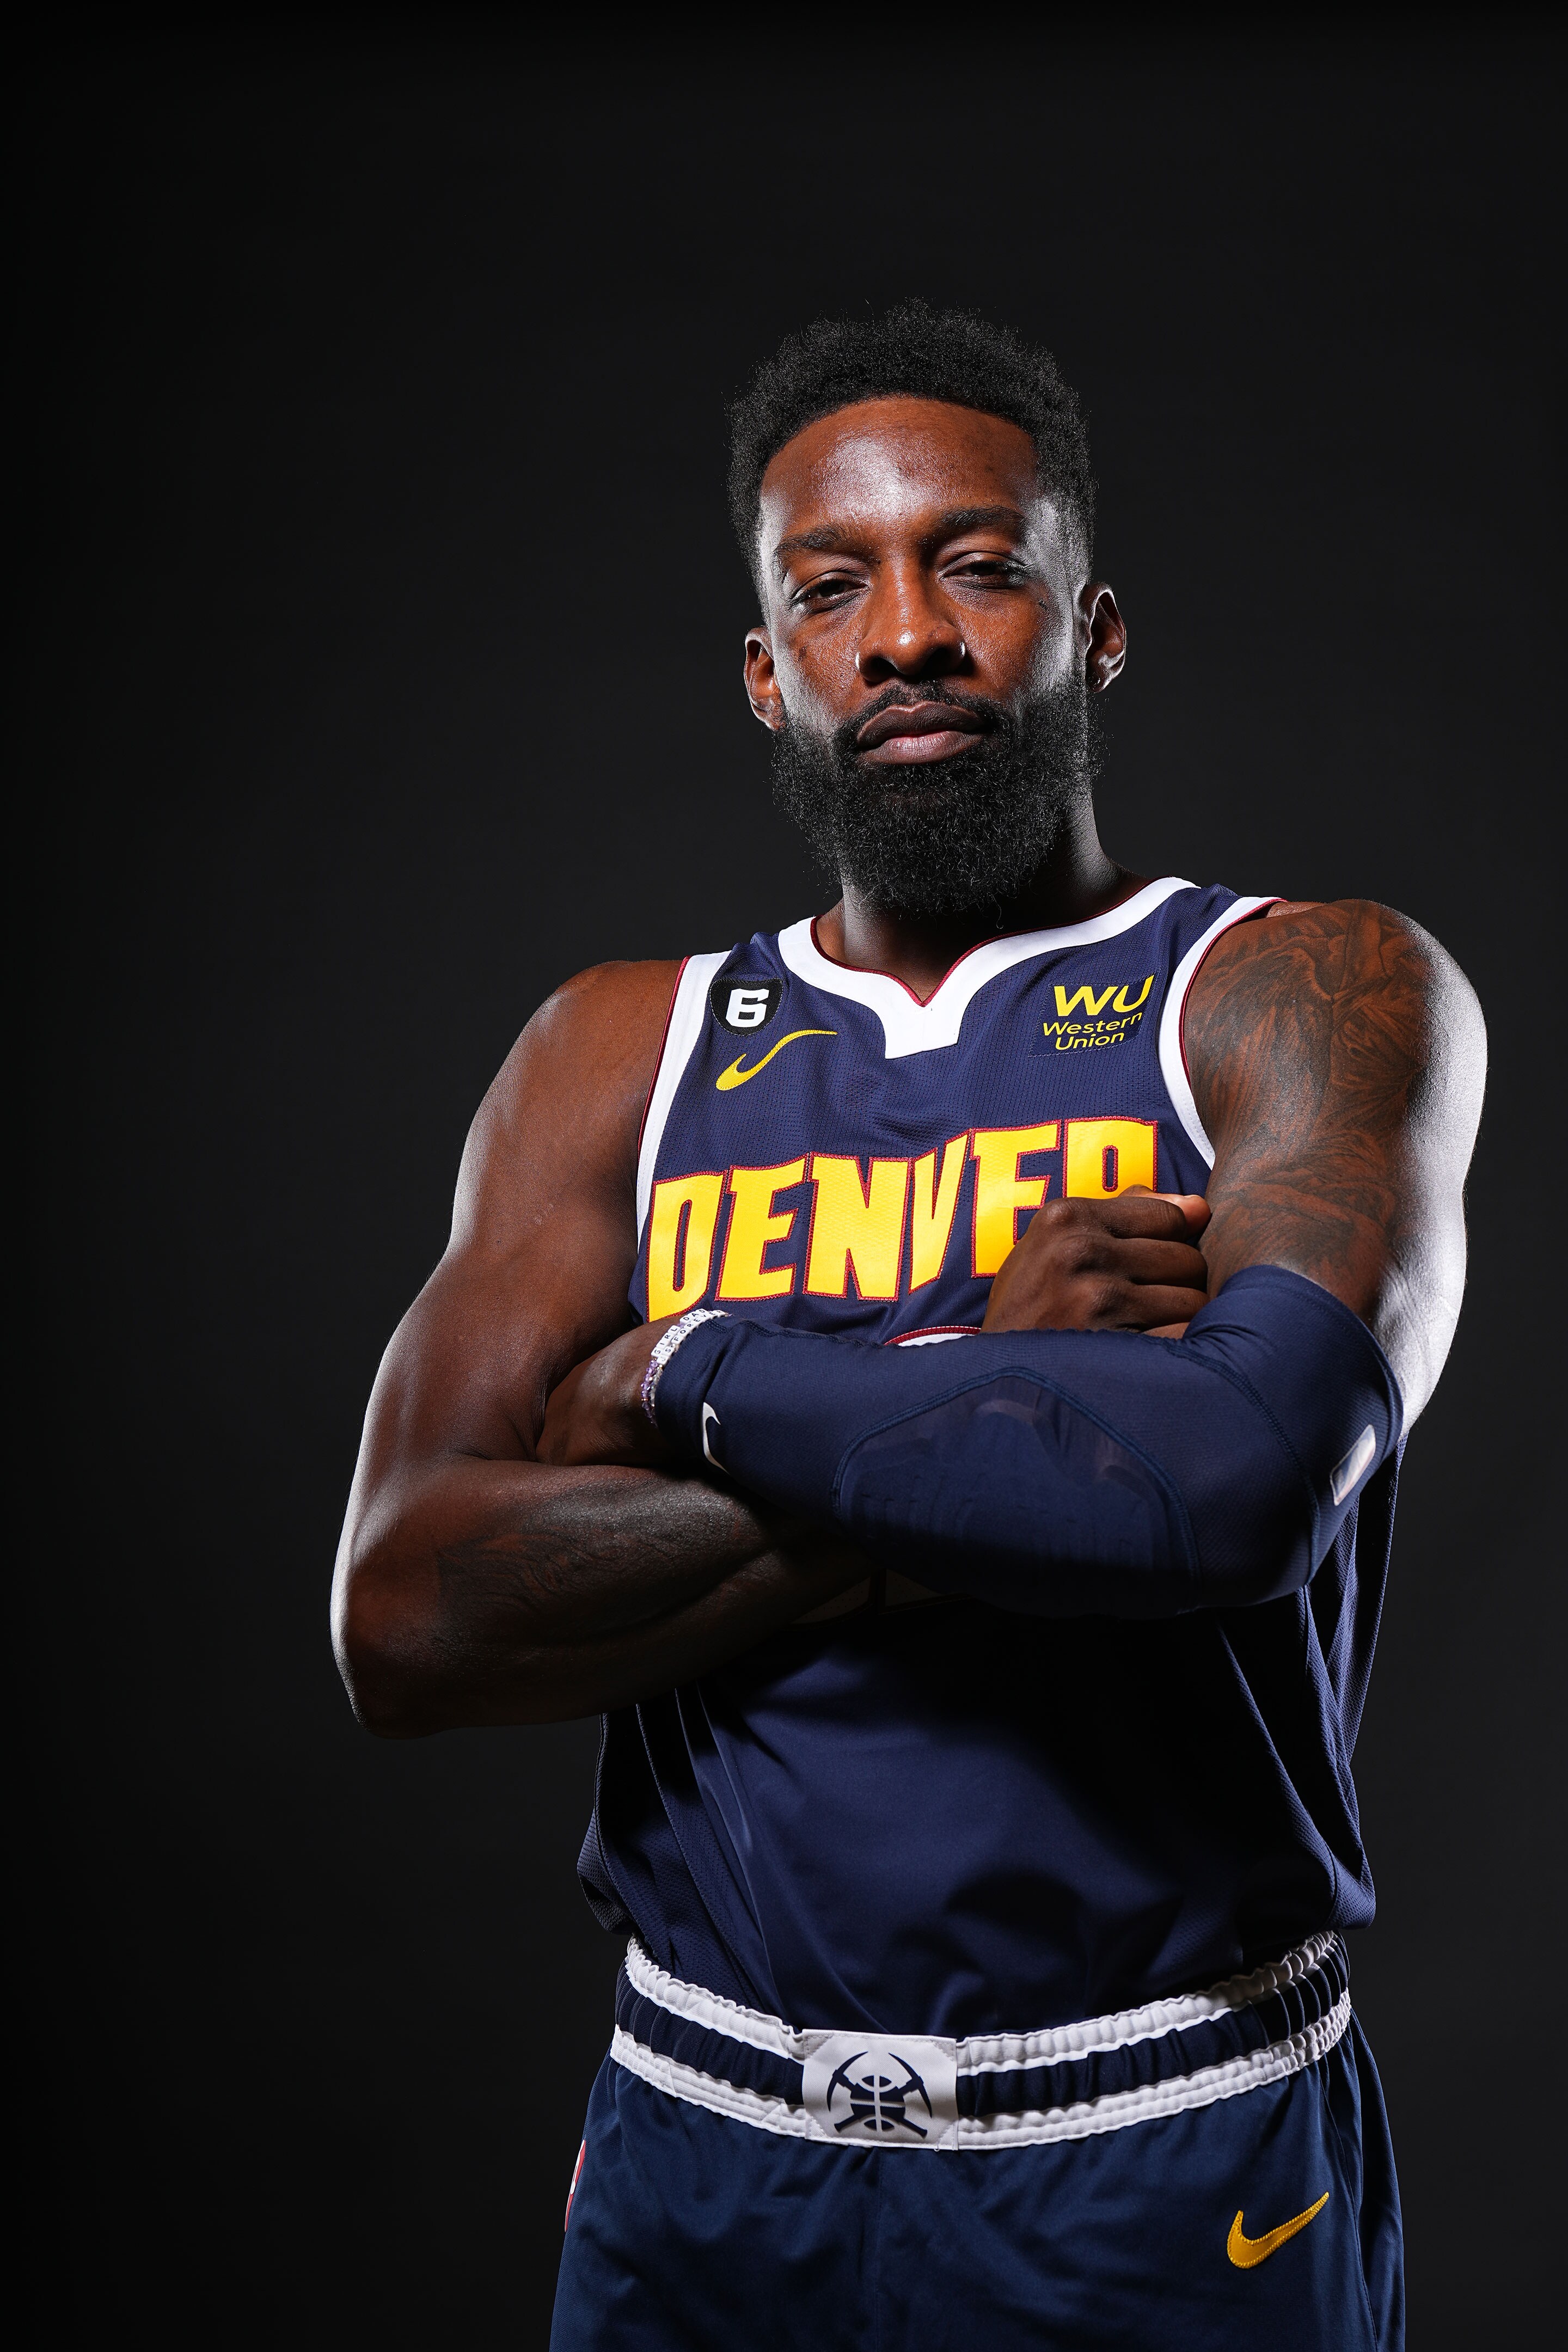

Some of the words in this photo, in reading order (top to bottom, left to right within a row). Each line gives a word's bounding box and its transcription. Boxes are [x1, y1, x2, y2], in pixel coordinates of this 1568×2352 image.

[725, 988, 770, 1028] 6
[1054, 975, 1154, 1016] WU
[1043, 1012, 1143, 1036] Western
[1055, 1033, 1125, 1050] Union
[654, 1328, 678, 1355] GIRL
[683, 1309, 706, 1321] DAD
